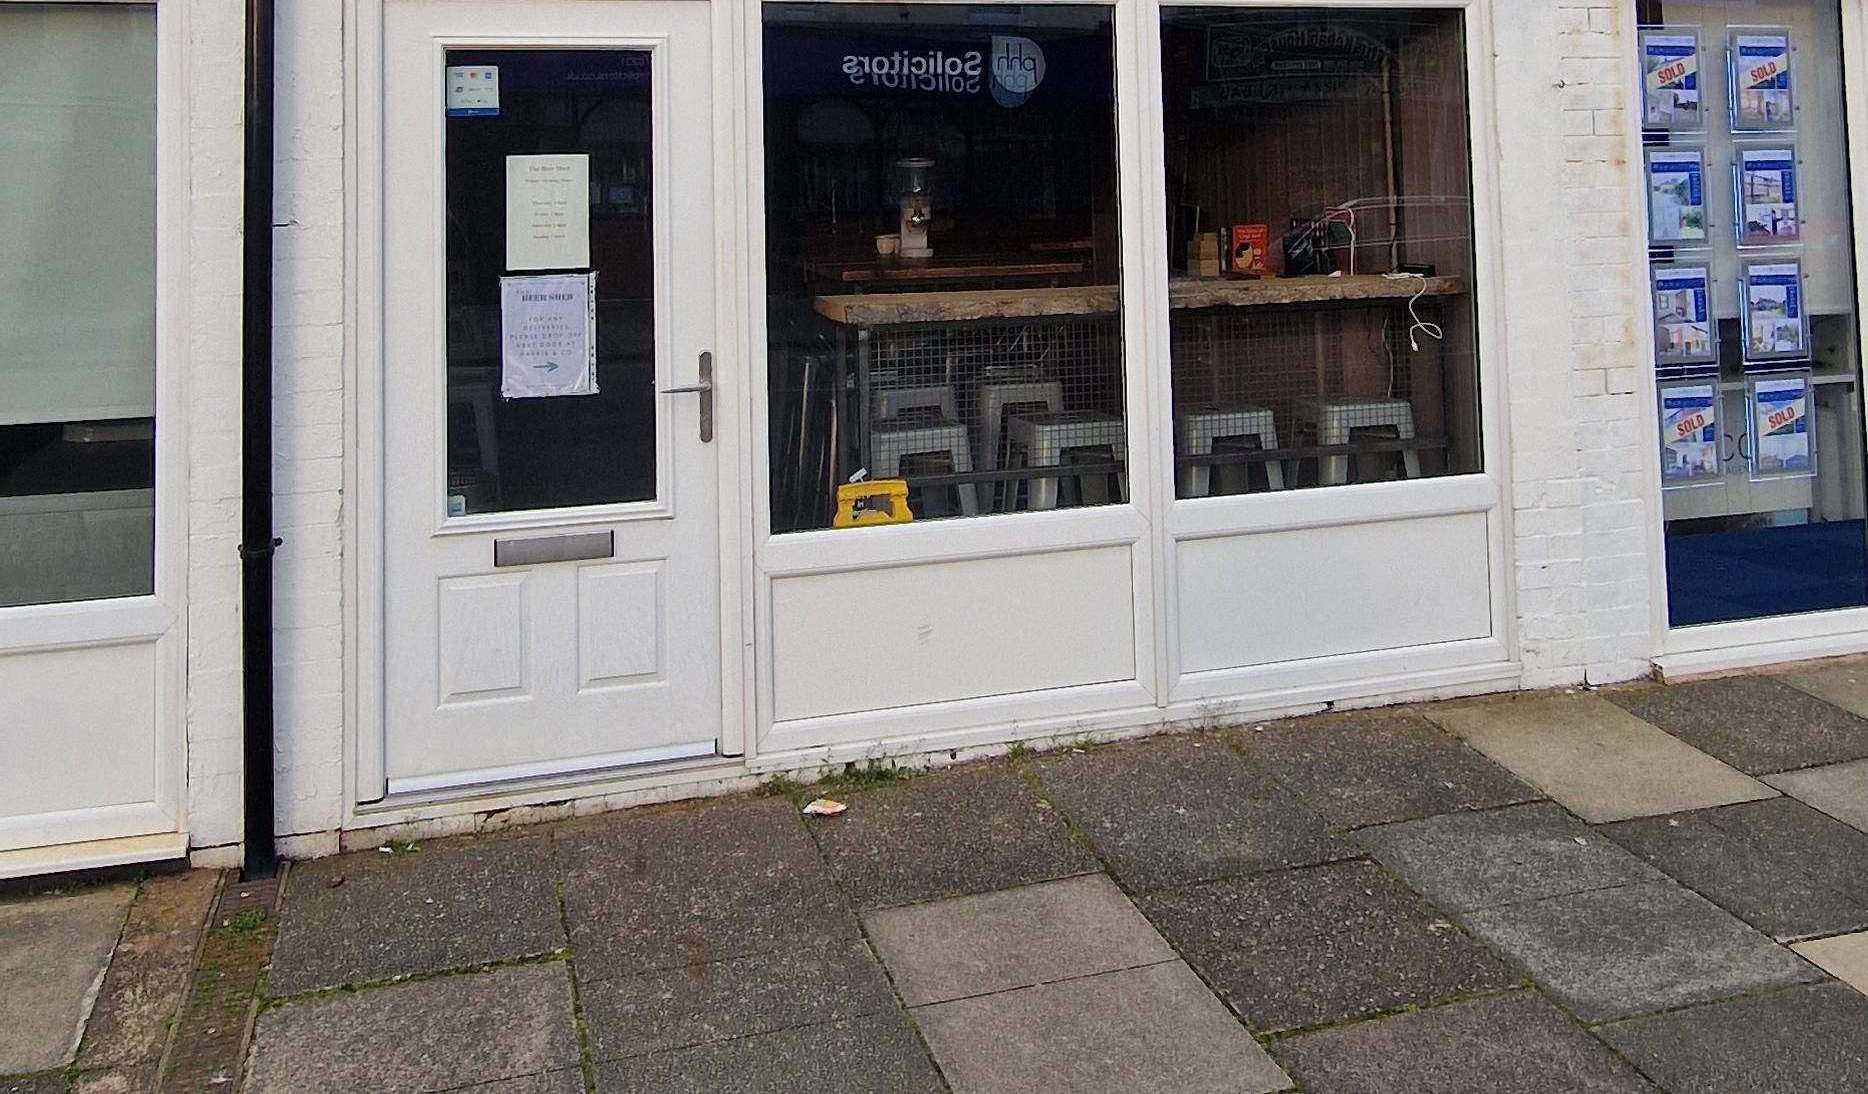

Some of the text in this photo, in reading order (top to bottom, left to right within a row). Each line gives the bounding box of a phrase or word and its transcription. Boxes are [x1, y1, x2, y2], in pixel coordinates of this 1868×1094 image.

[1657, 62, 1686, 85] SOLD
[1750, 61, 1777, 83] SOLD
[1676, 414, 1706, 437] SOLD
[1768, 406, 1796, 429] SOLD
